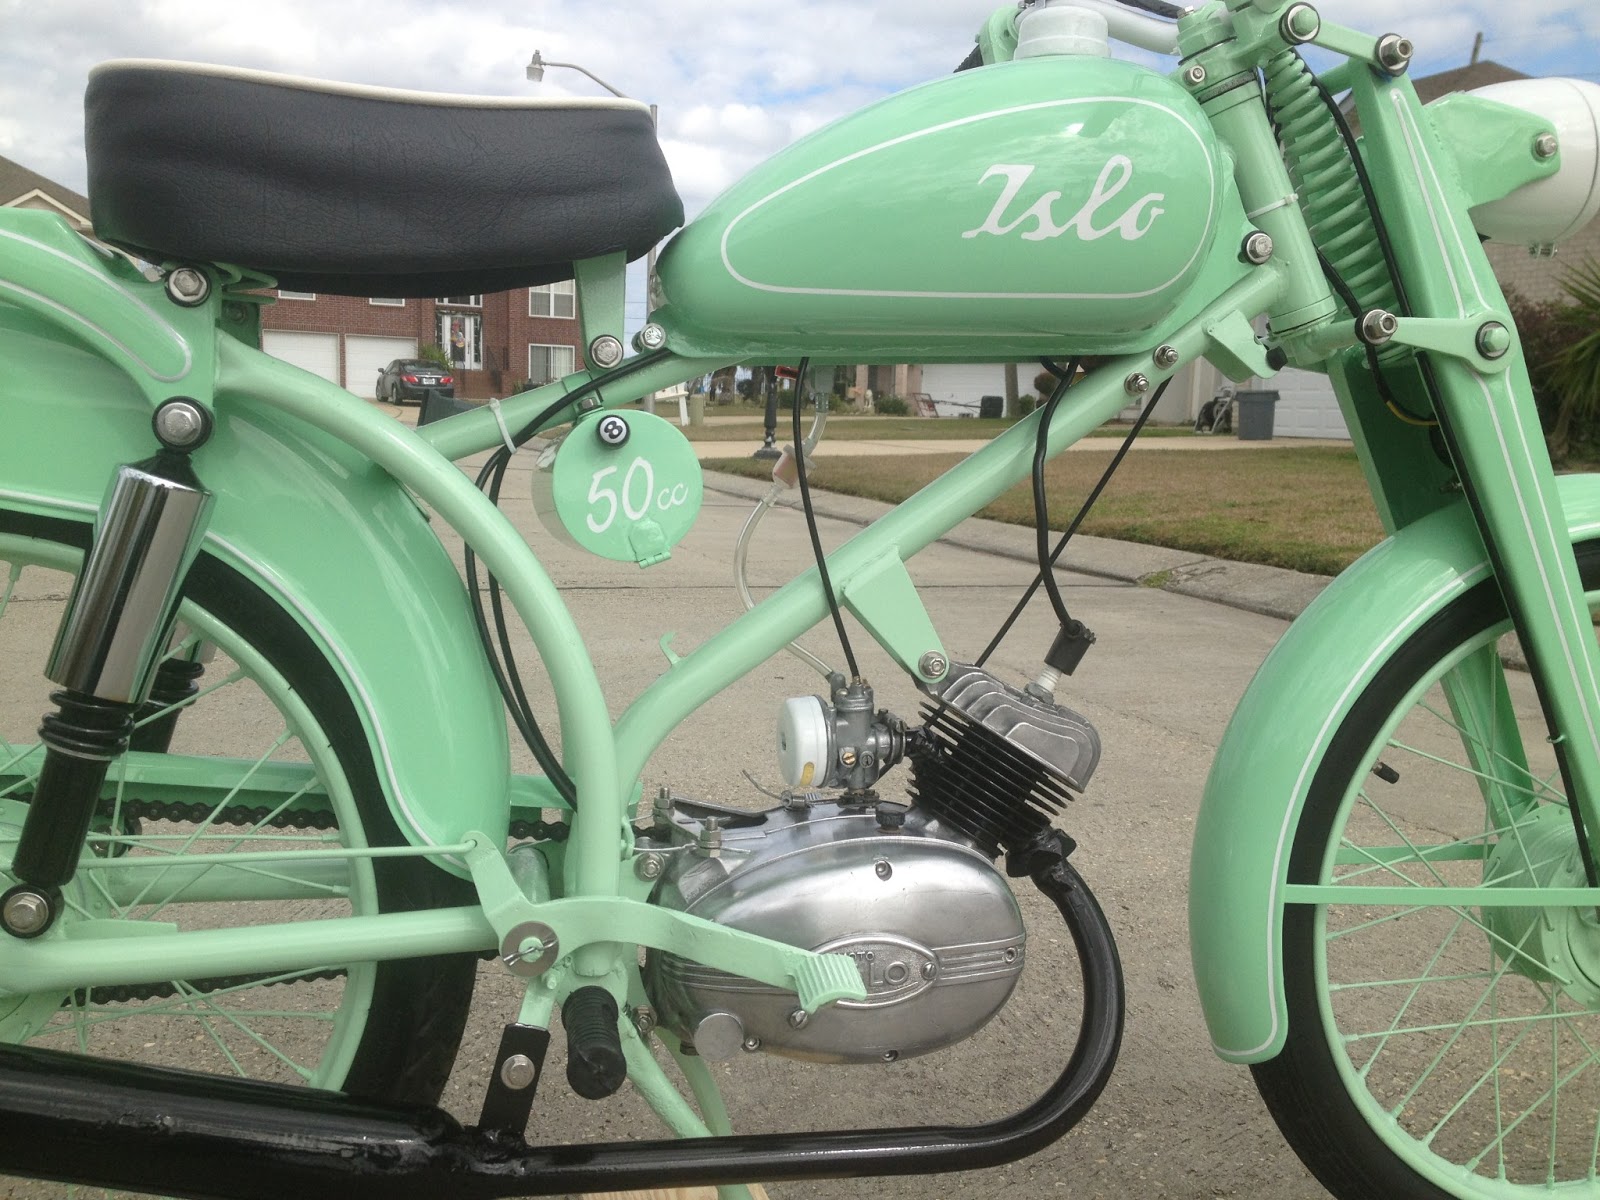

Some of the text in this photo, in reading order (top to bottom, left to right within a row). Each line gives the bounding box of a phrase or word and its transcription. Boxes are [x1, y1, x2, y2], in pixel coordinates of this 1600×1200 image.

[961, 154, 1165, 241] Islo
[604, 420, 623, 440] 8
[837, 951, 875, 961] OTO
[860, 960, 910, 986] LO
